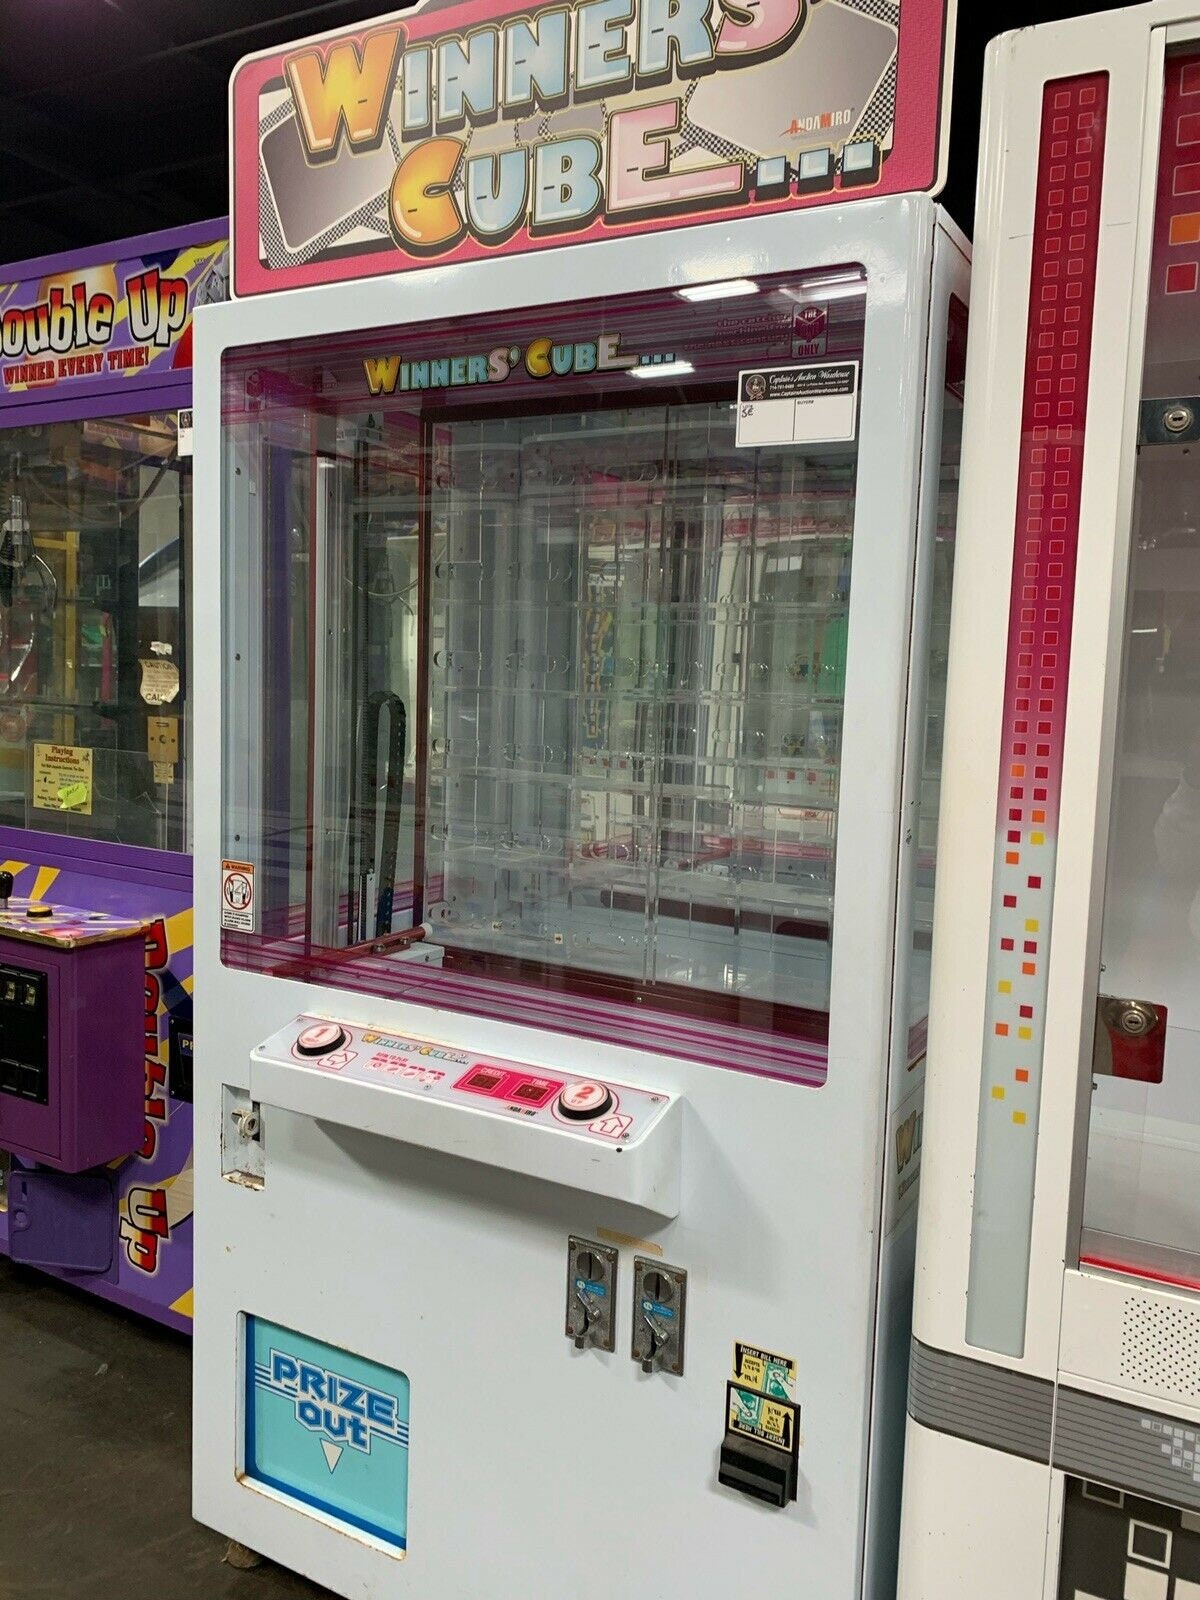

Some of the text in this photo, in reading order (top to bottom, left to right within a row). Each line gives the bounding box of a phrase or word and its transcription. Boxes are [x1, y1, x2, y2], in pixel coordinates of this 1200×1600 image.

[789, 109, 852, 135] ANDAMIRO
[0, 267, 188, 358] ouble Up
[798, 343, 820, 356] ONLY
[4, 345, 150, 385] WINNER EVERY TIME!
[769, 373, 794, 385] Captain's
[45, 754, 80, 764] Instructions
[51, 746, 74, 757] Playing
[575, 1086, 596, 1099] 2
[119, 1187, 169, 1273] Up
[740, 1345, 788, 1367] INSERT BILL HERE
[272, 1352, 396, 1430] PRIZE
